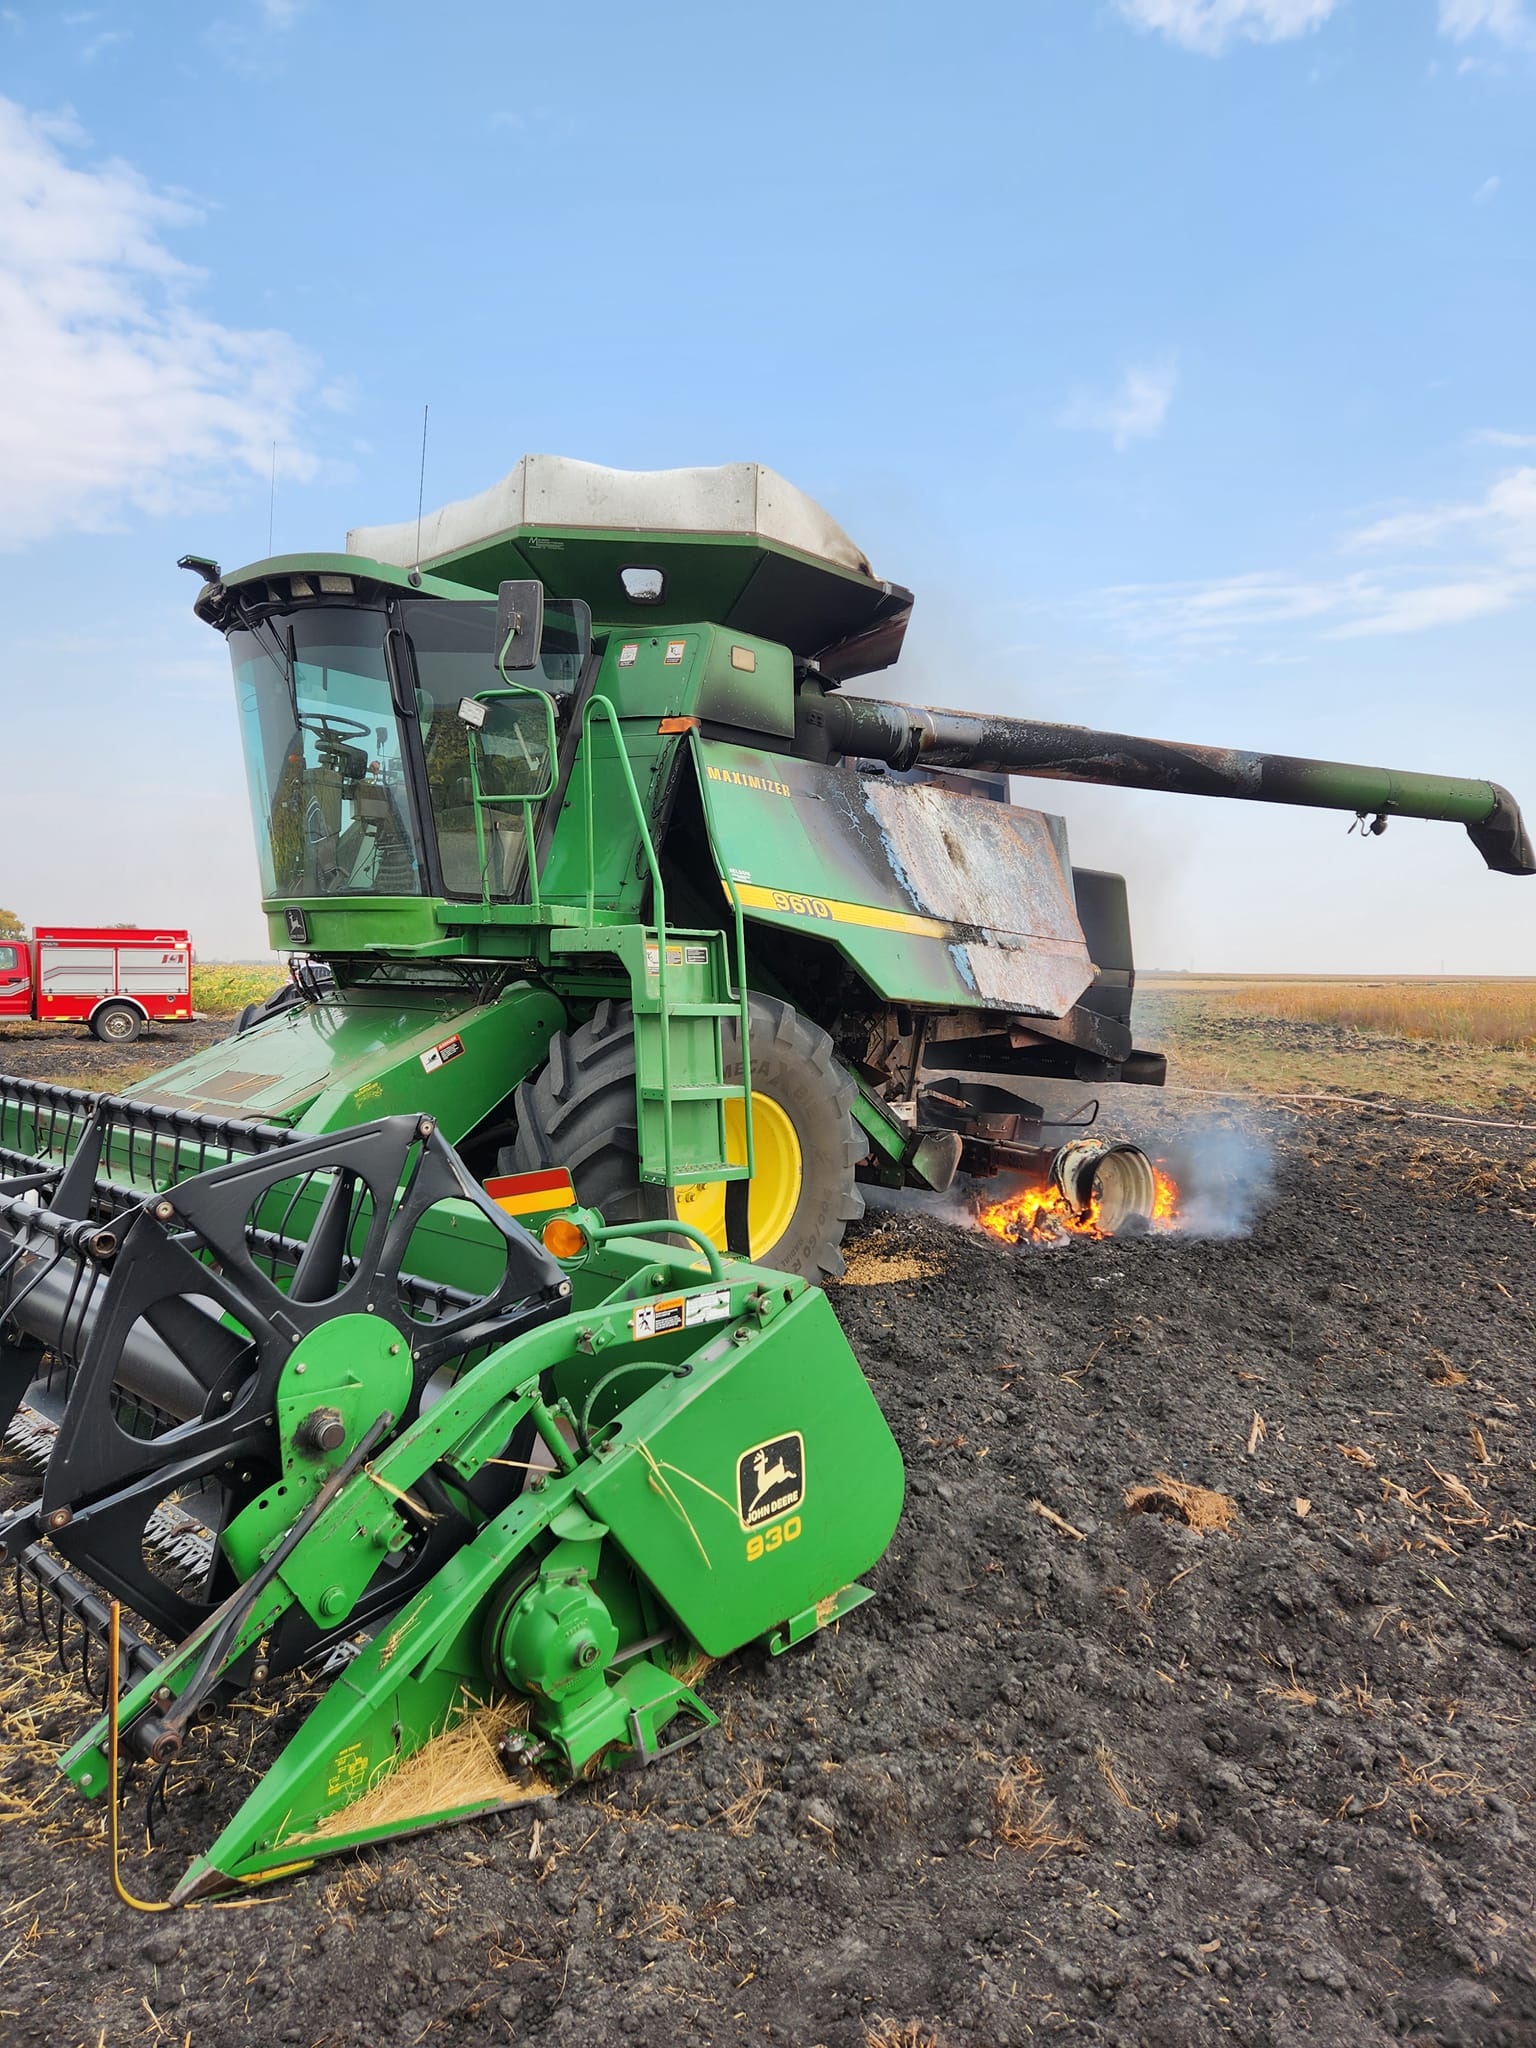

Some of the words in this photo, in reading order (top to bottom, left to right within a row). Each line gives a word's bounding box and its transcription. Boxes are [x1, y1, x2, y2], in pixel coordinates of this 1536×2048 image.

[706, 765, 791, 798] MAXIMIZER
[772, 890, 832, 920] 9610
[746, 1503, 770, 1524] JOHN
[770, 1490, 799, 1513] DEERE
[746, 1515, 802, 1562] 930
